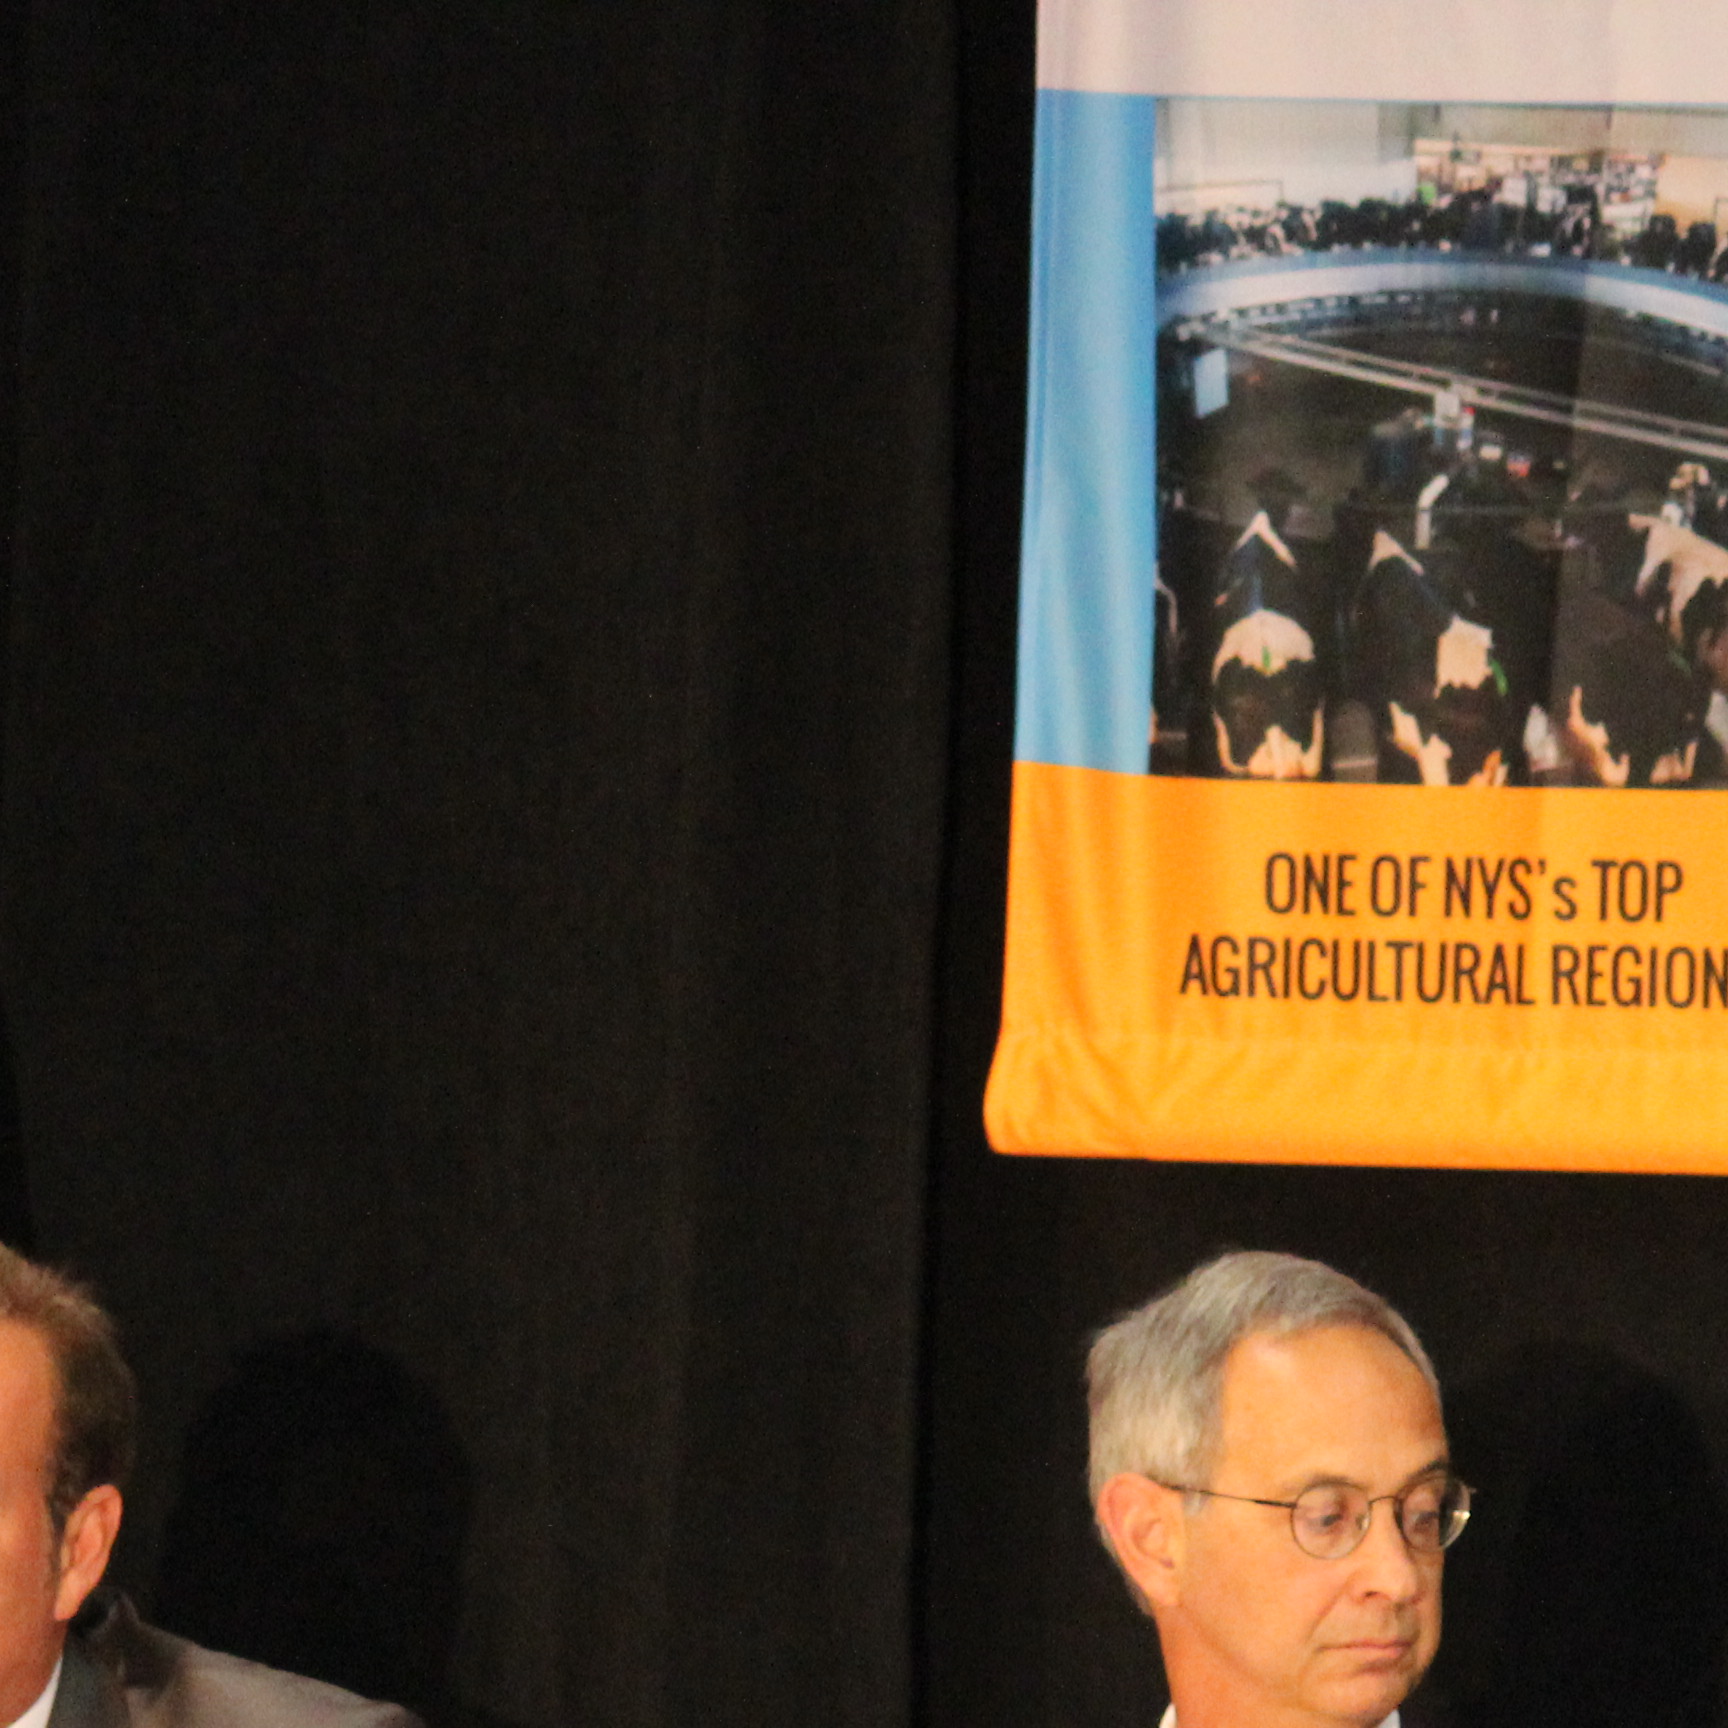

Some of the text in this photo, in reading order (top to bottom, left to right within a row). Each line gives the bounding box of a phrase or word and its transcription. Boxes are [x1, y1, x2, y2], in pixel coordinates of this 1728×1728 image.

[1266, 853, 1355, 916] ONE
[1371, 855, 1429, 917] OF
[1592, 860, 1683, 922] TOP
[1180, 934, 1534, 1005] AGRICULTURAL
